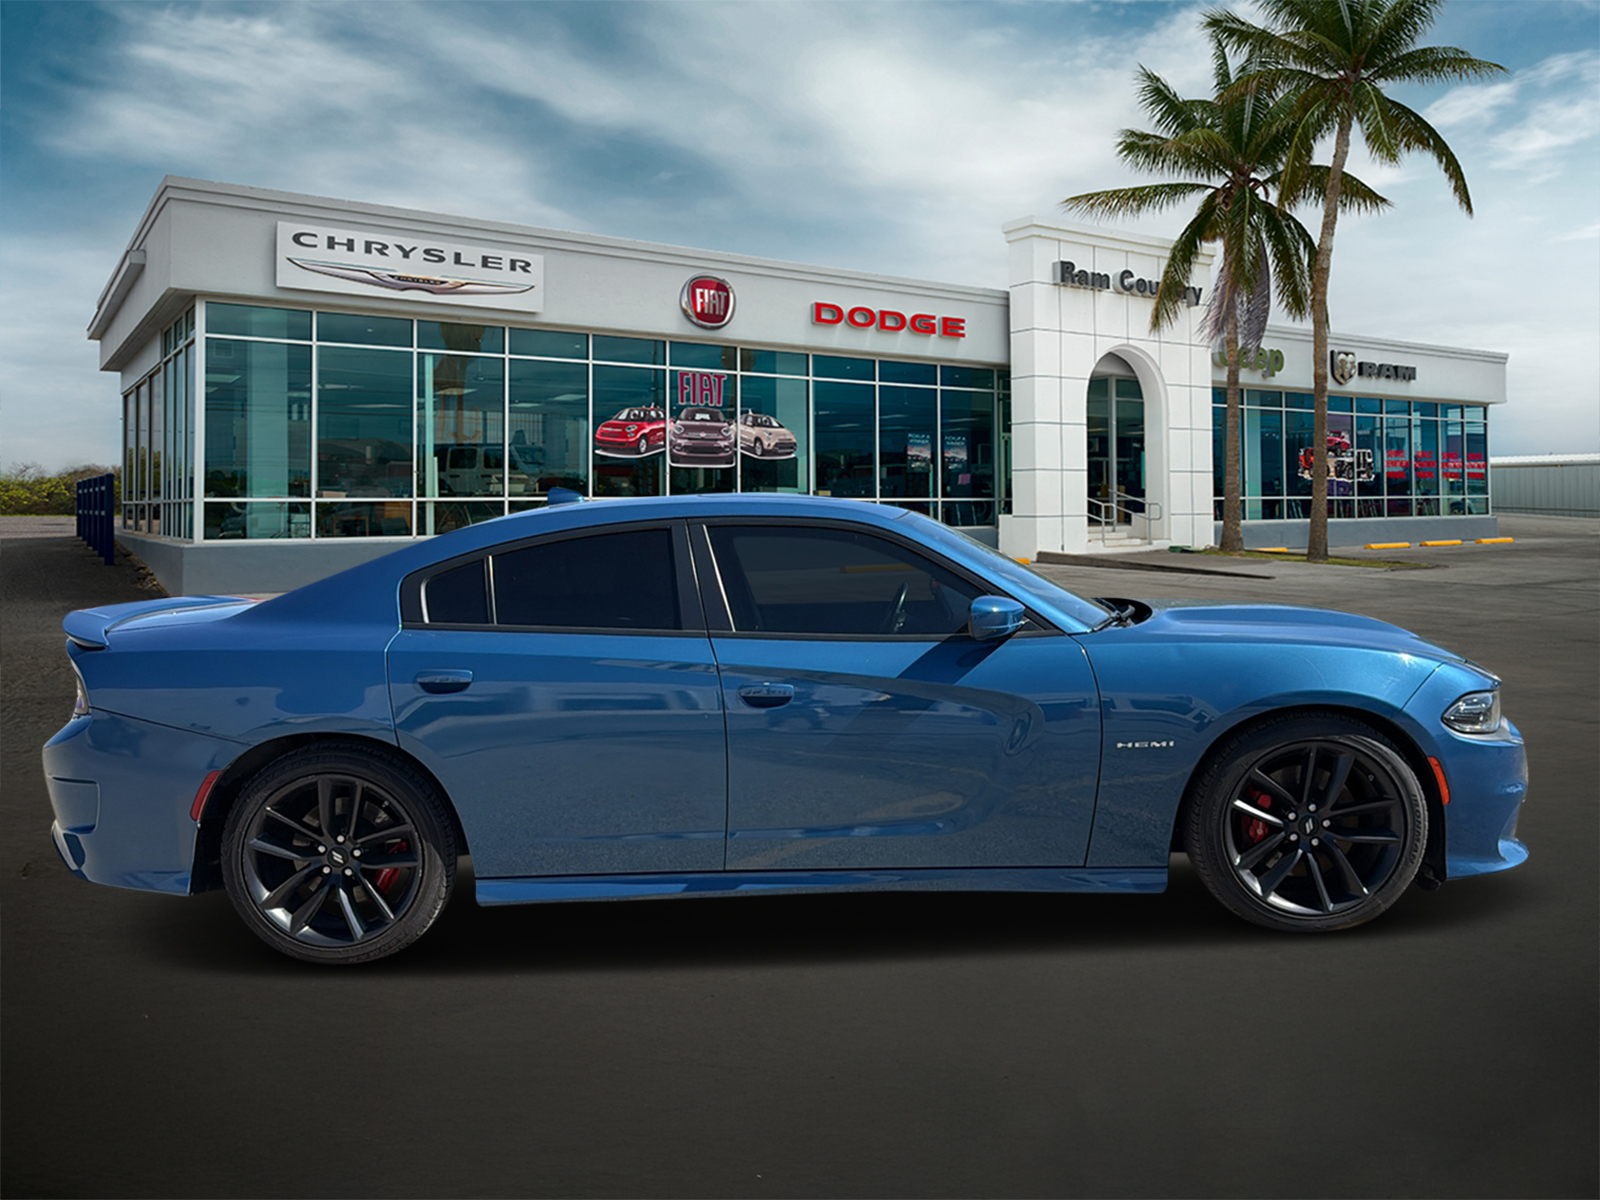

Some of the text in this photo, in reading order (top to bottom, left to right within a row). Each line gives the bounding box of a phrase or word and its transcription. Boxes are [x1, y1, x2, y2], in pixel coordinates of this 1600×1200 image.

[292, 231, 532, 274] CHRYSLER
[1055, 260, 1203, 307] Ram Coury
[695, 288, 727, 316] FIAT
[812, 301, 967, 339] DODGE
[678, 371, 727, 407] FIAT
[1358, 361, 1416, 381] RAM
[1116, 741, 1175, 749] HEMI
